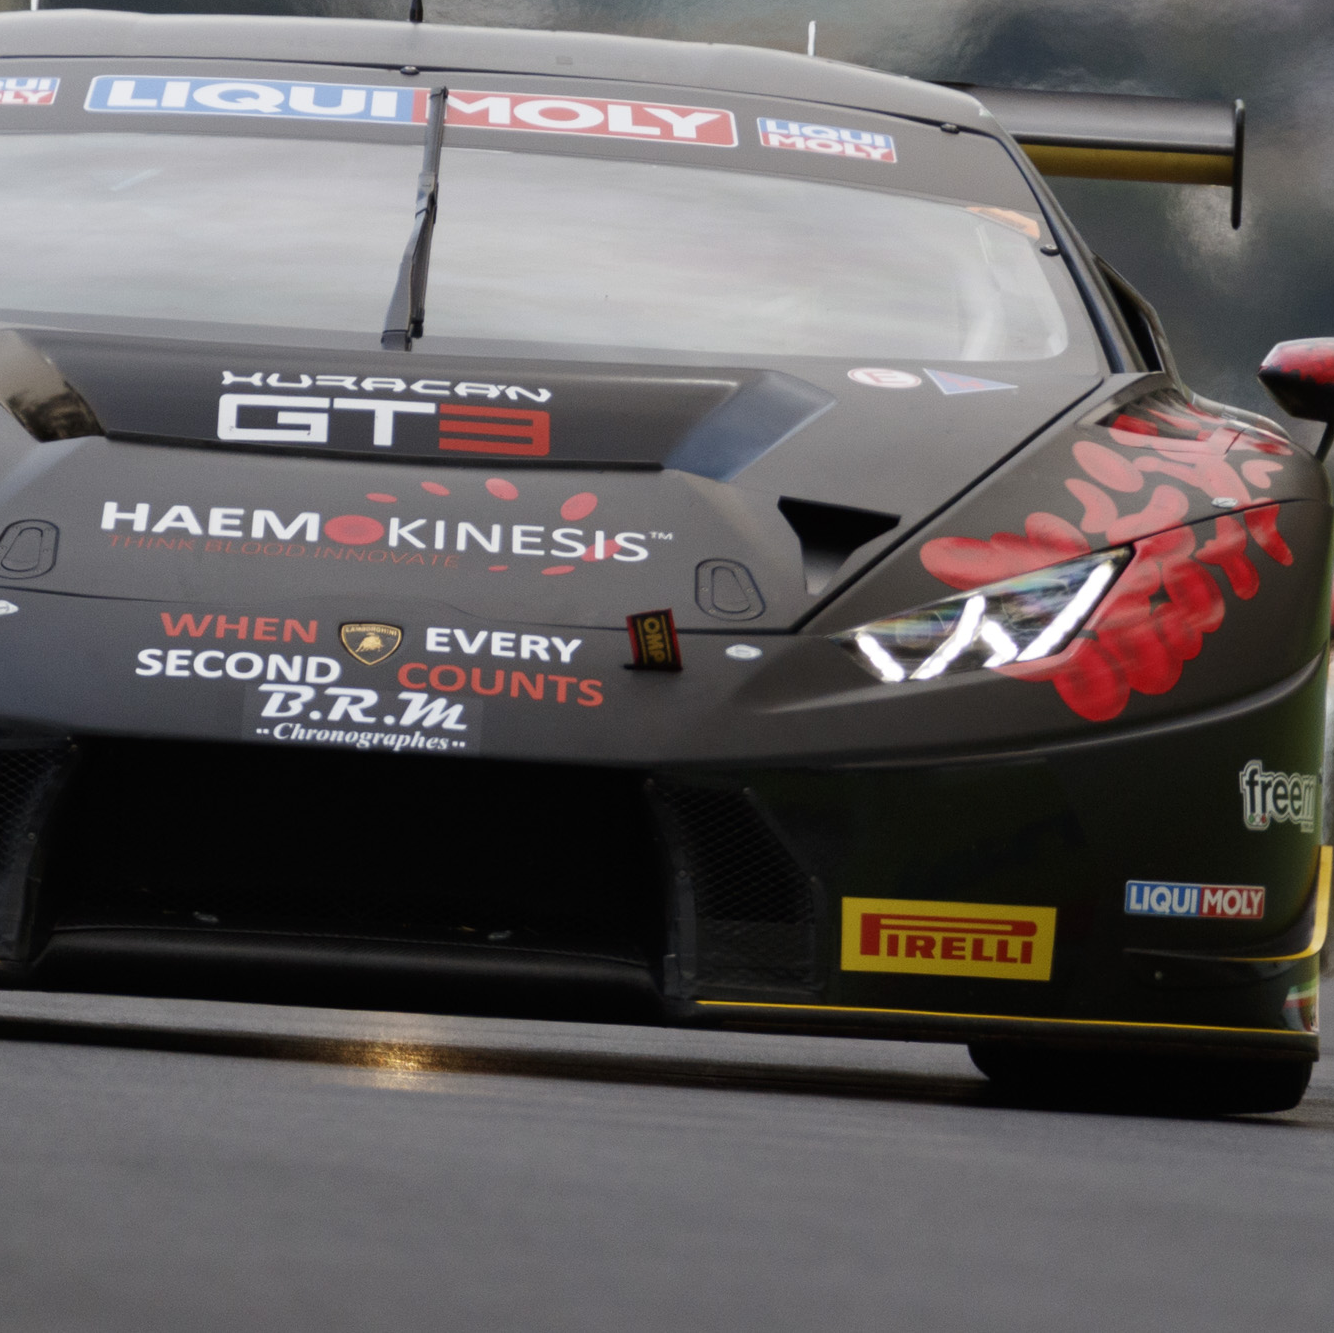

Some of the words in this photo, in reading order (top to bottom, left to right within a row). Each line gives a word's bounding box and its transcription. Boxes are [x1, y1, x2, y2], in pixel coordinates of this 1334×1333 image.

[106, 78, 398, 118] LIQUI
[425, 89, 723, 140] MOLY
[765, 119, 887, 147] LIQUI
[768, 133, 891, 160] MOLY
[216, 392, 551, 457] GT3
[108, 534, 197, 552] THINK
[313, 545, 461, 568] INNOVATE
[160, 612, 318, 644] WHEN
[424, 627, 582, 663] EVERY
[643, 617, 666, 663] OMP
[135, 648, 341, 684] SECOND
[397, 662, 604, 707] COUNTS
[258, 683, 468, 730] B.R.M
[272, 722, 449, 751] Chronographes
[1129, 884, 1199, 914] LIQUI
[1202, 888, 1264, 916] MOLY
[860, 912, 1038, 965] PIRELLI
